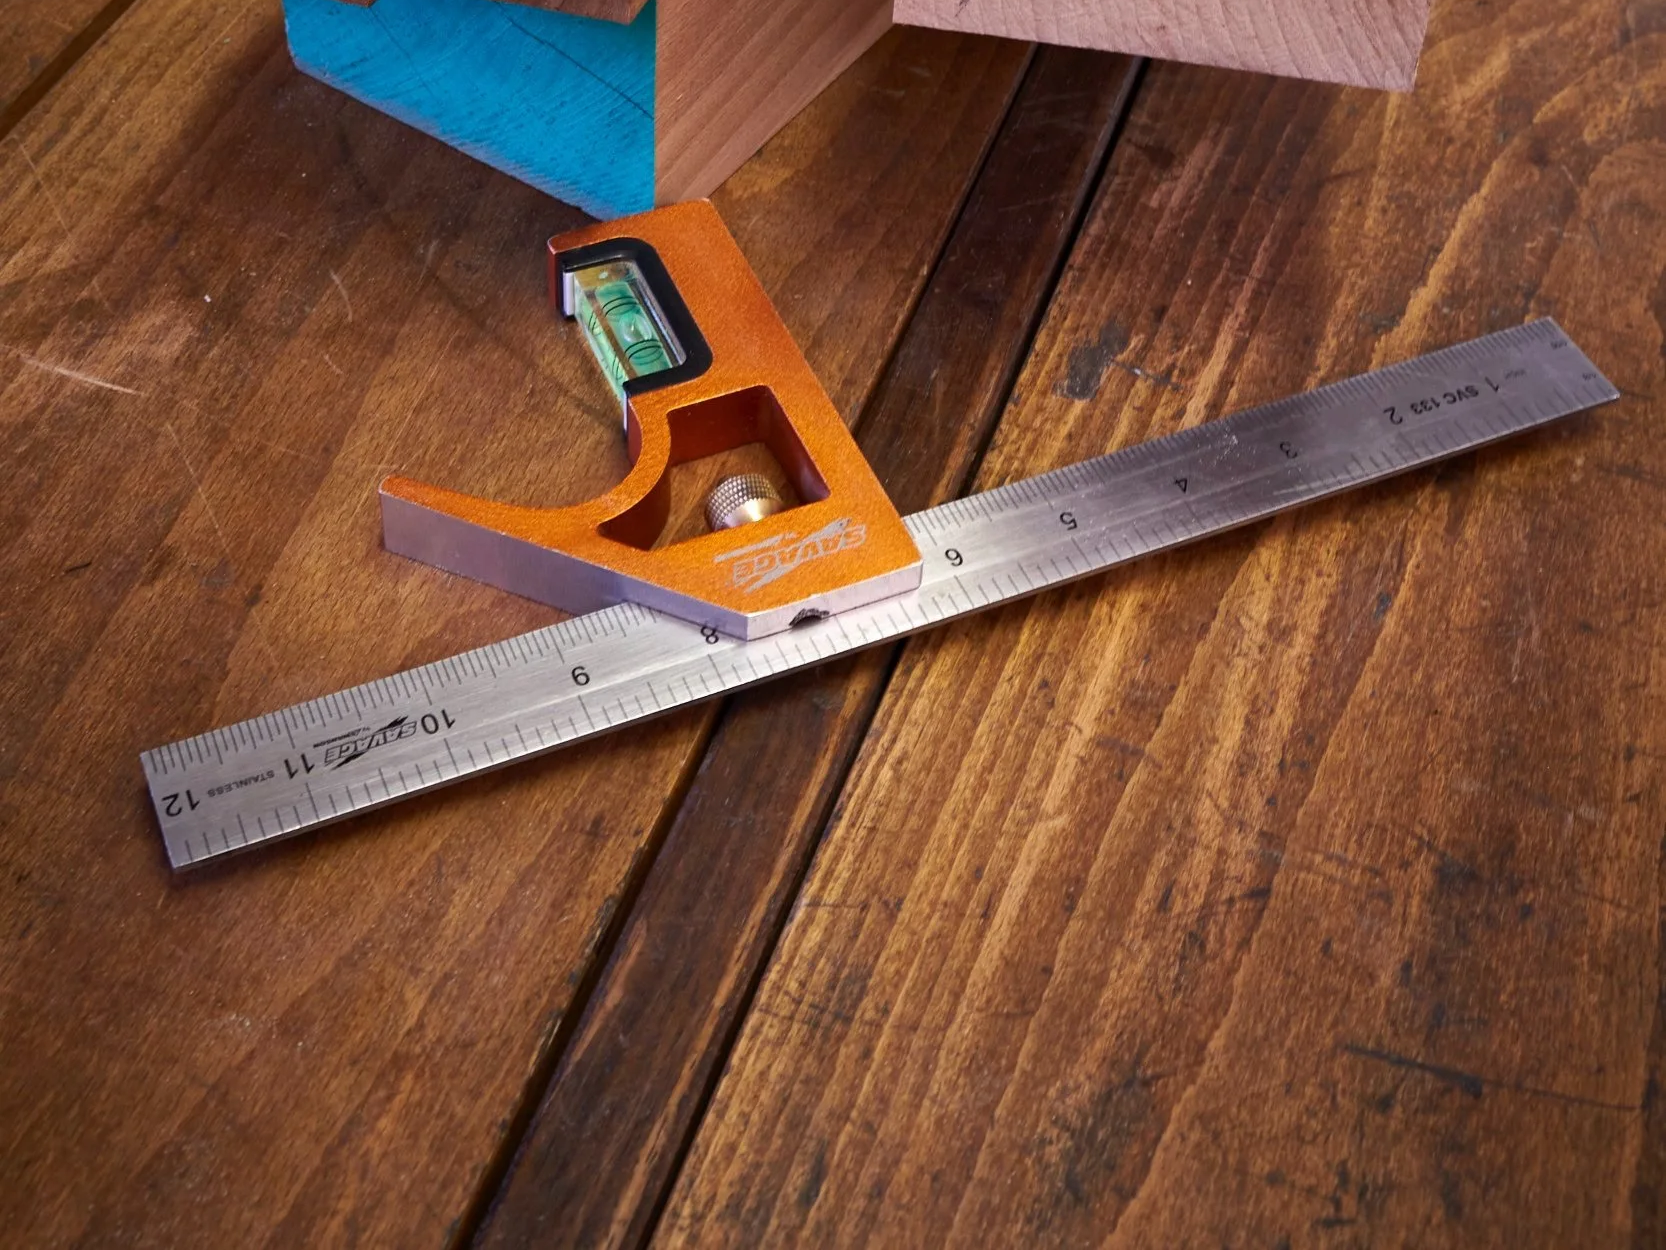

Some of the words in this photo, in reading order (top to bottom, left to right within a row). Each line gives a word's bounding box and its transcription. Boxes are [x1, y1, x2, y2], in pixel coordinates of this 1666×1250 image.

[1442, 385, 1479, 405] SVC
[1484, 376, 1500, 394] 1
[1383, 406, 1403, 425] 2
[1410, 397, 1441, 414] 133
[1279, 440, 1298, 460] 3
[1173, 476, 1189, 494] 4
[1059, 511, 1078, 531] 5
[733, 523, 867, 590] SAVAGE
[700, 625, 719, 644] 8
[421, 709, 456, 735] 10
[324, 720, 418, 765] SAVAGE
[284, 753, 315, 779] 11
[207, 770, 275, 797] STAINLESS
[162, 790, 200, 817] 12
